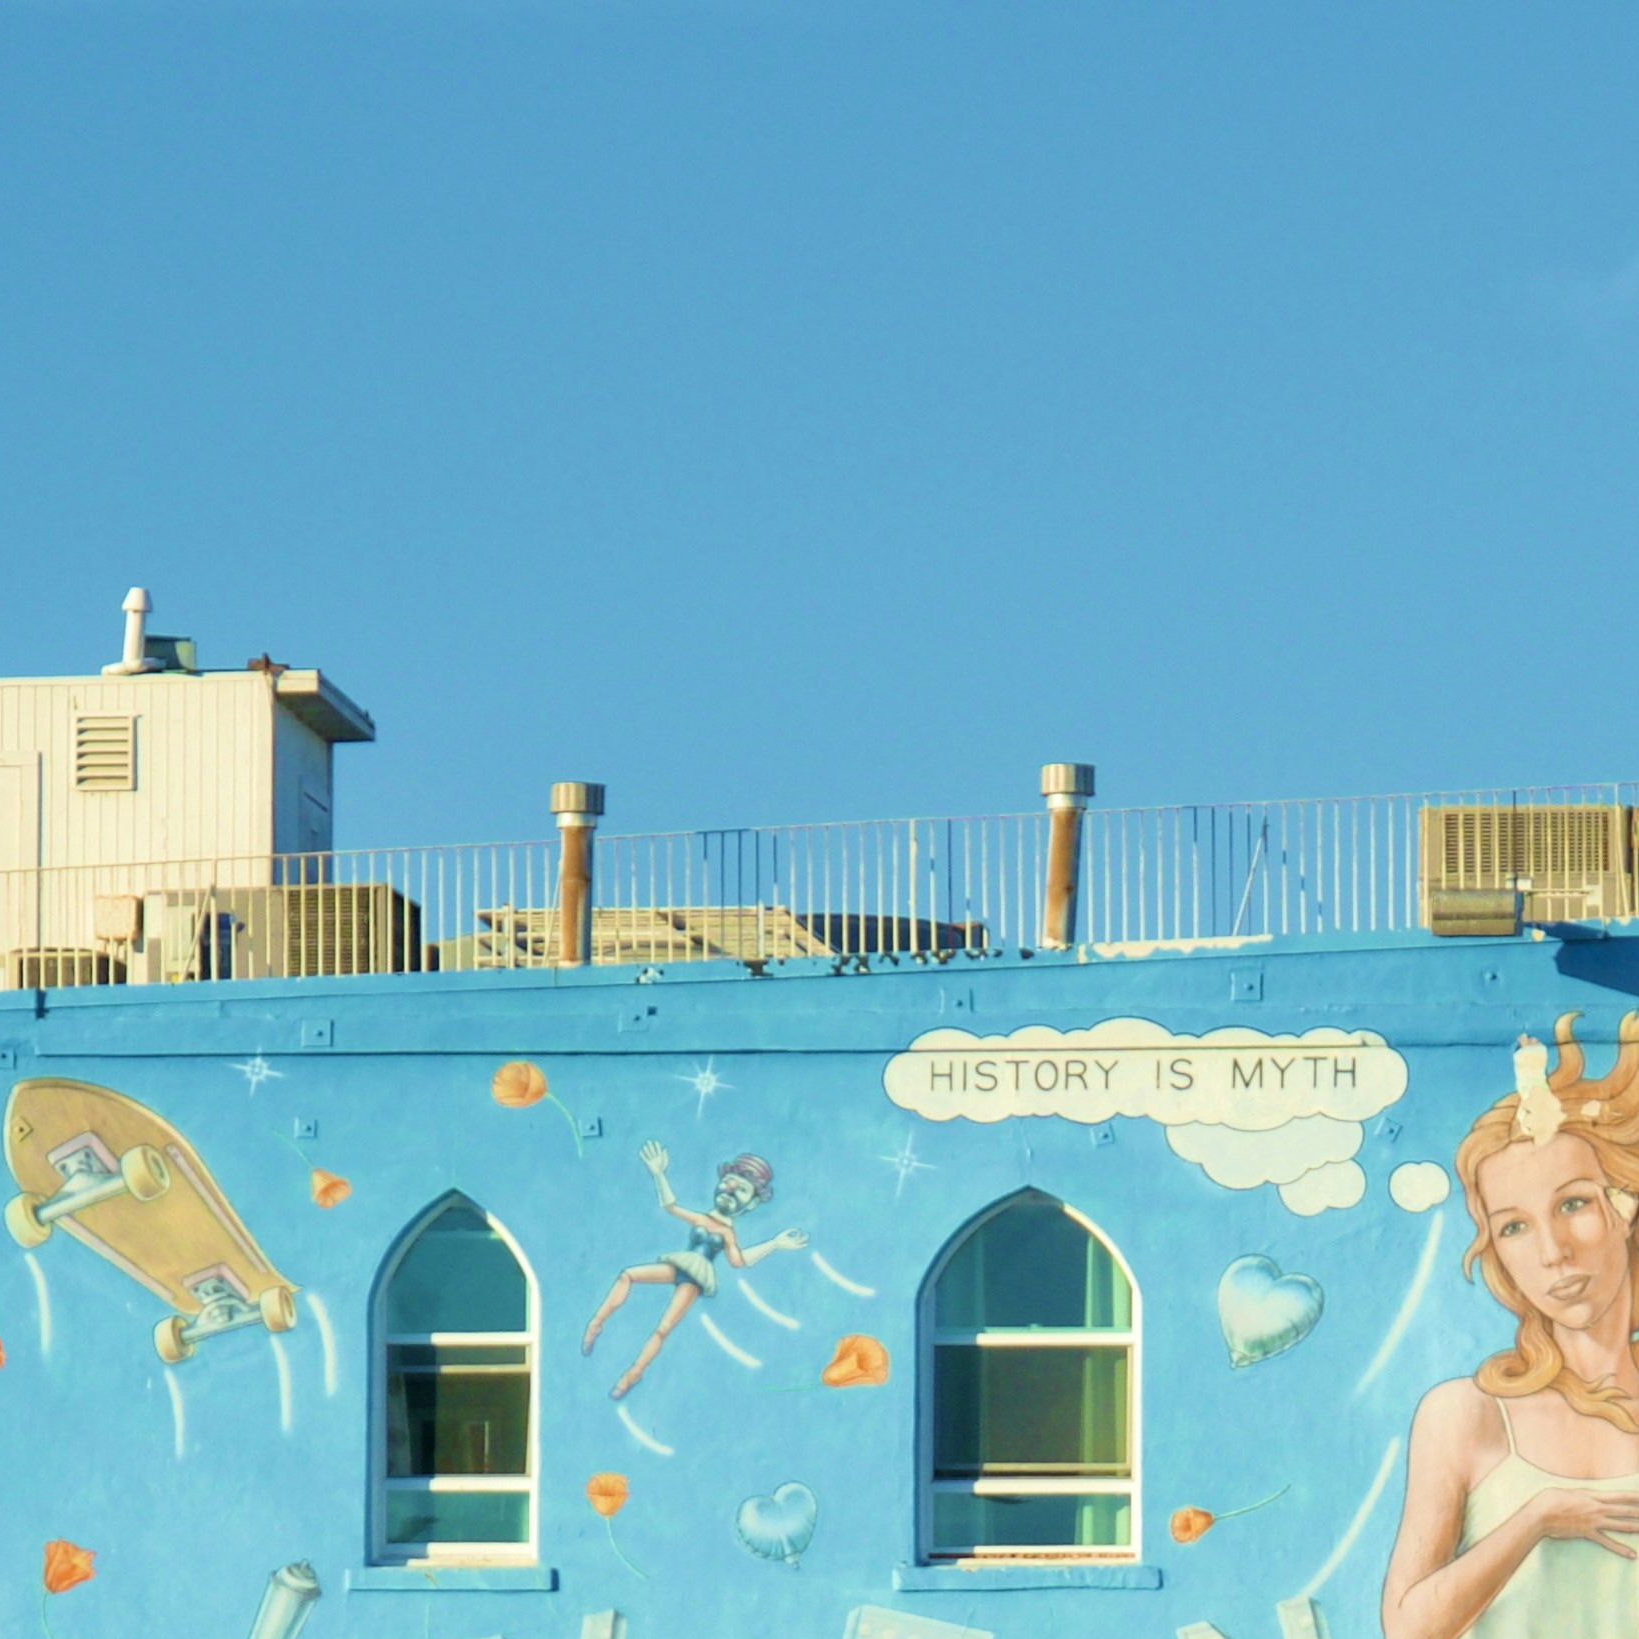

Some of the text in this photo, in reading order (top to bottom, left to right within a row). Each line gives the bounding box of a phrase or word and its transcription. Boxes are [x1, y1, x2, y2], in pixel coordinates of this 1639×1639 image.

[930, 1055, 1358, 1094] HISTORY IS MYTH
